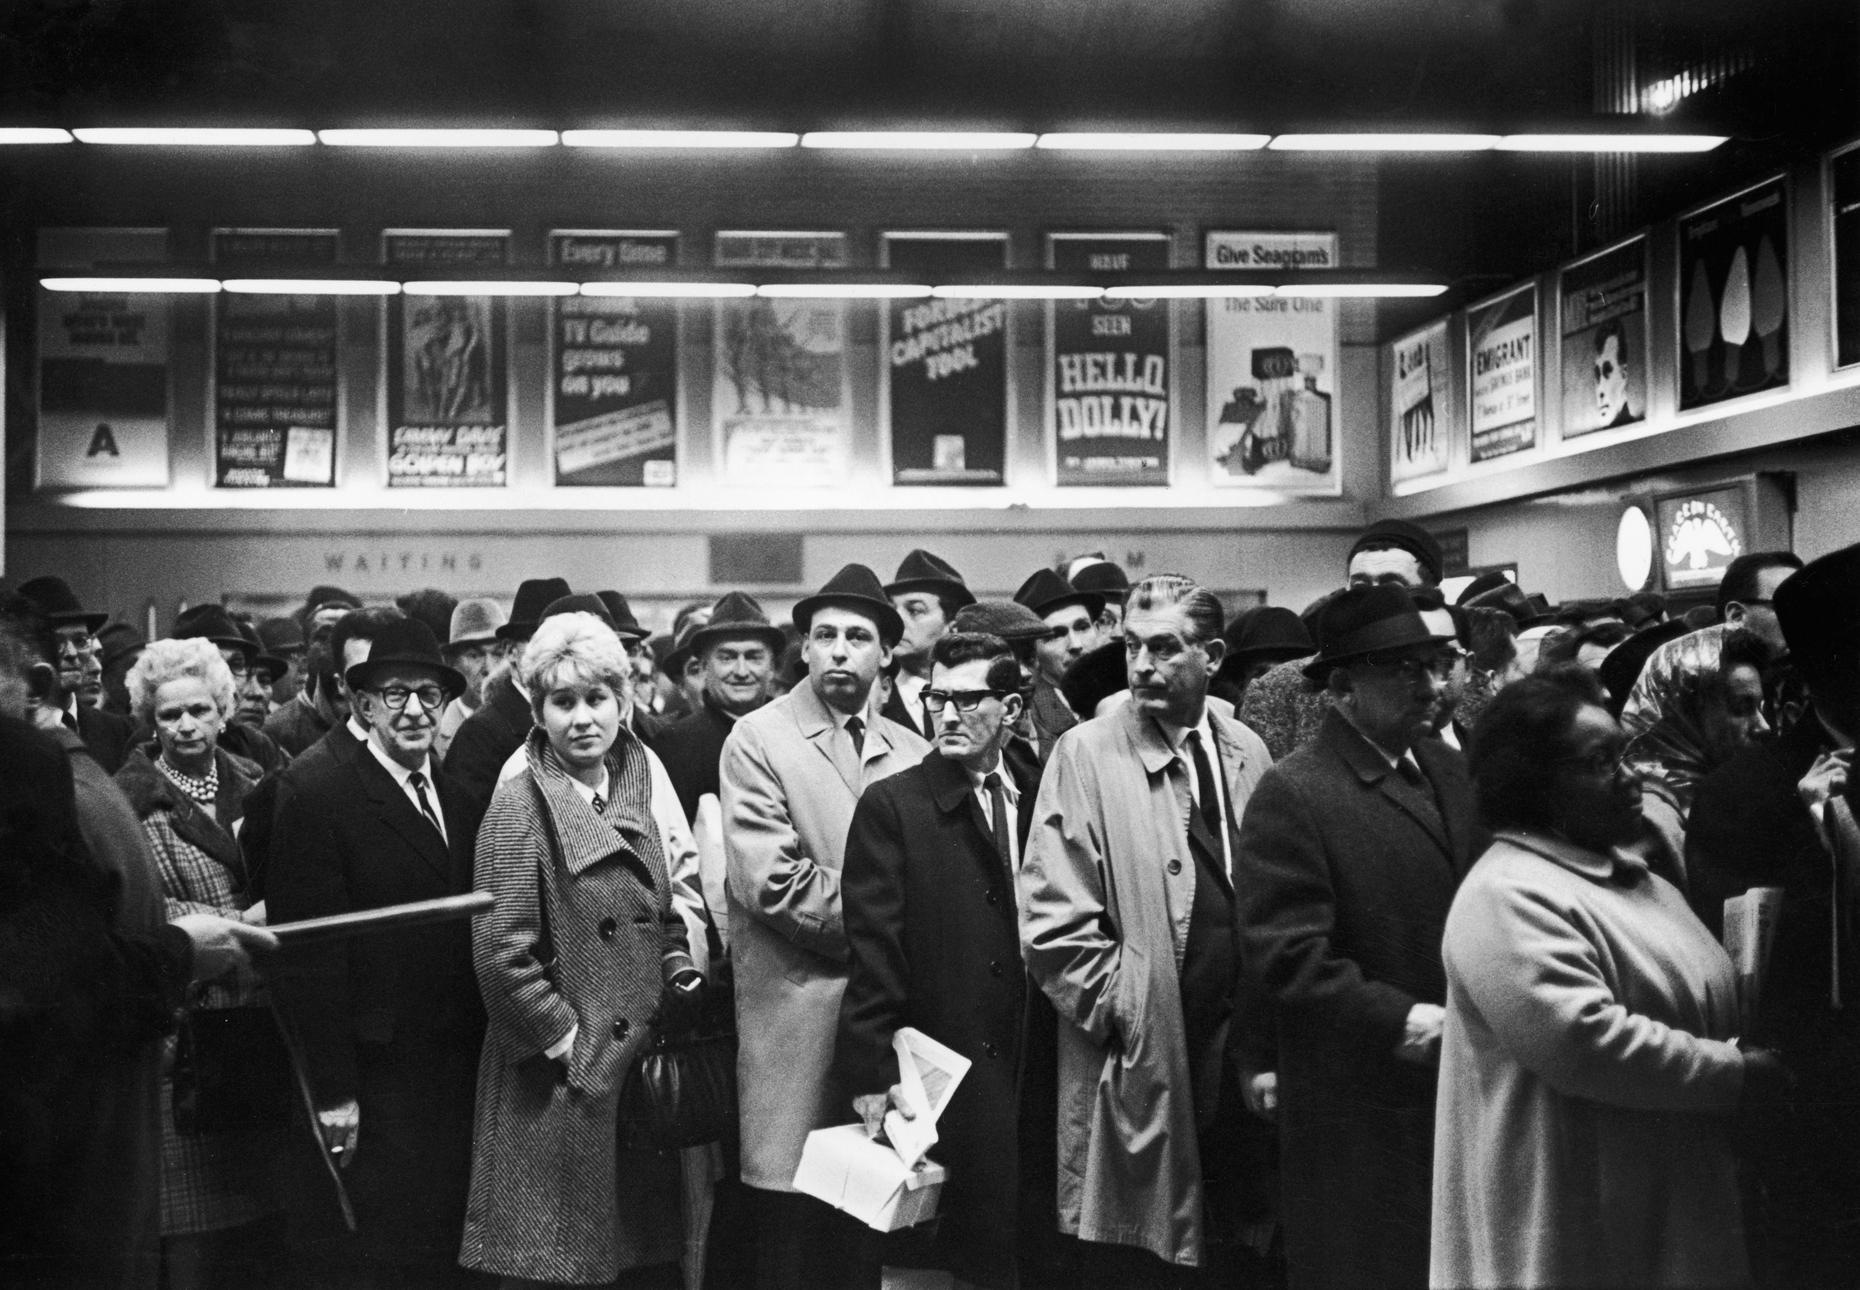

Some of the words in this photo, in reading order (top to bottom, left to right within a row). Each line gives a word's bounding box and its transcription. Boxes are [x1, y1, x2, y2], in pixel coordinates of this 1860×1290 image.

[1216, 244, 1250, 265] Give
[1056, 396, 1168, 441] DOLLY!
[86, 423, 120, 458] A
[323, 551, 482, 572] WAITING
